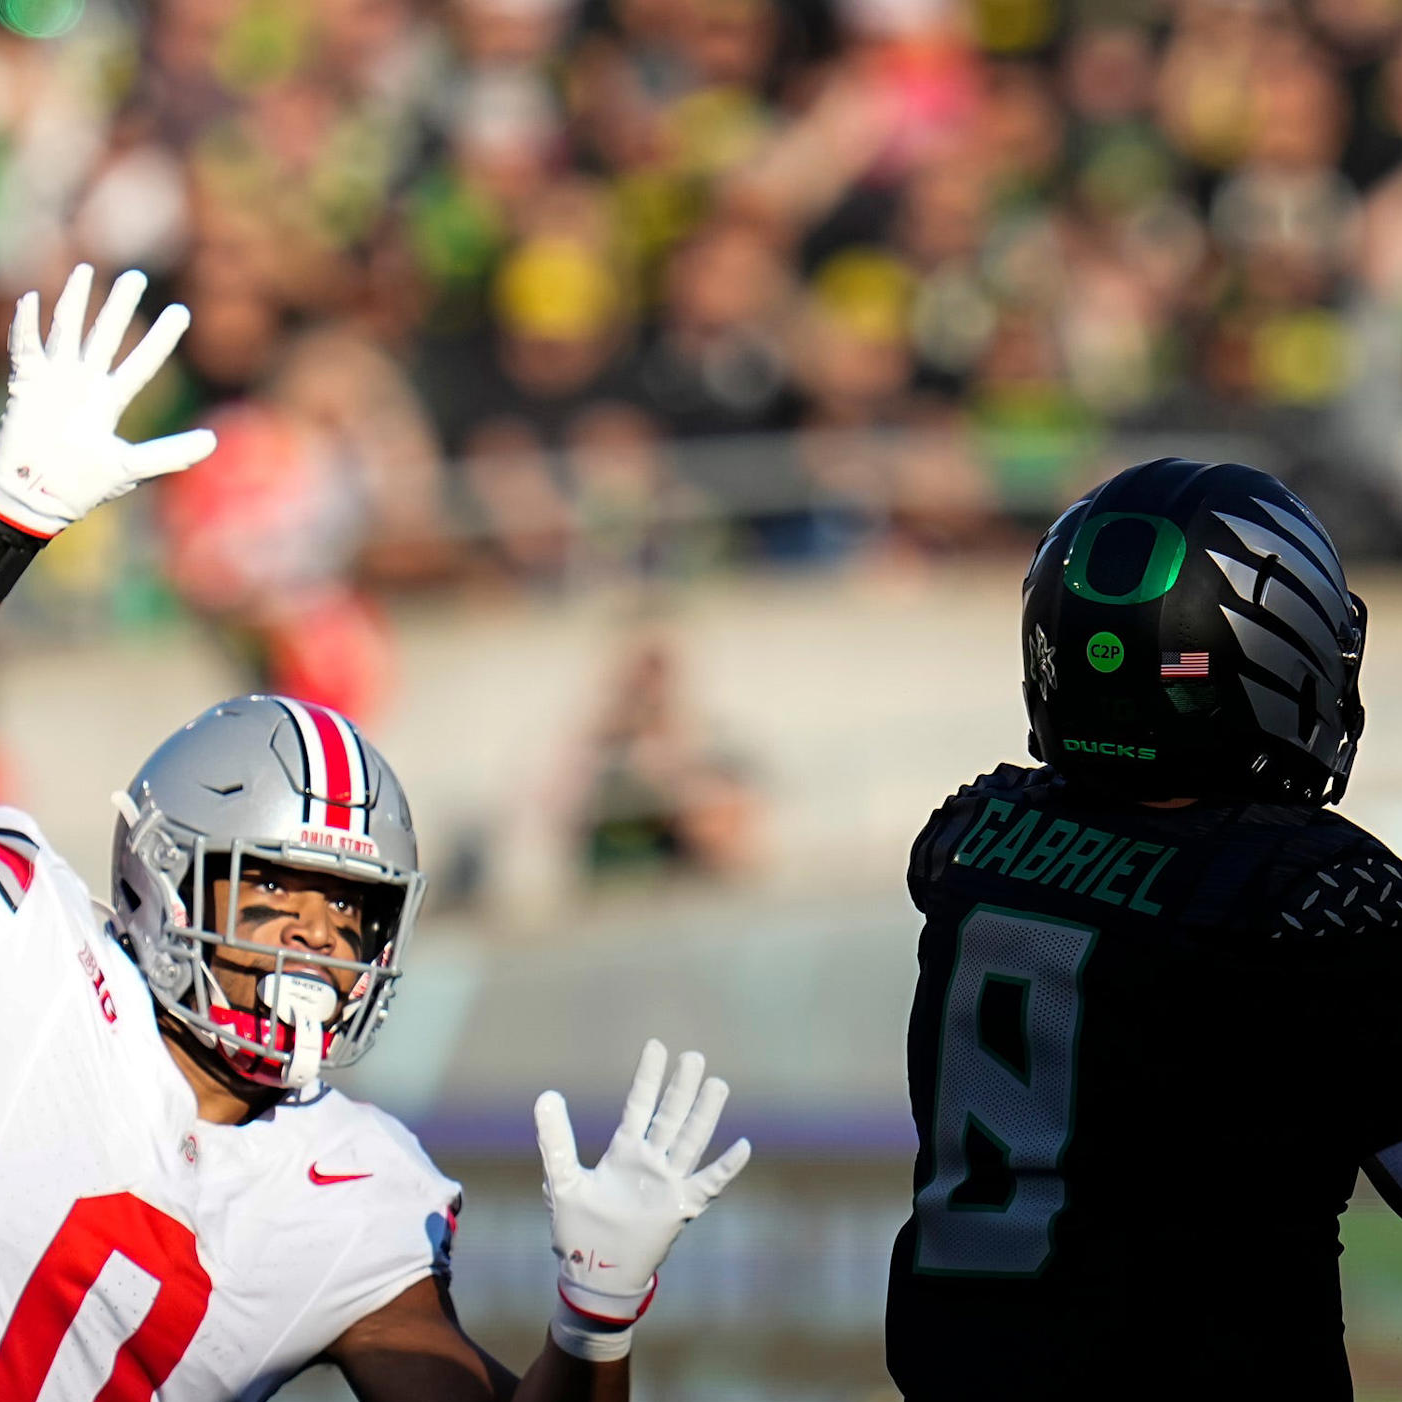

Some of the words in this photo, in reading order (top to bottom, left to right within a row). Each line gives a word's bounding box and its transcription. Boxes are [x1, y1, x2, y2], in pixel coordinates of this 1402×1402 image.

[1091, 645, 1121, 660] C2P
[1062, 739, 1157, 760] DUCKS
[951, 797, 1180, 917] GABRIEL
[913, 902, 1101, 1279] 8
